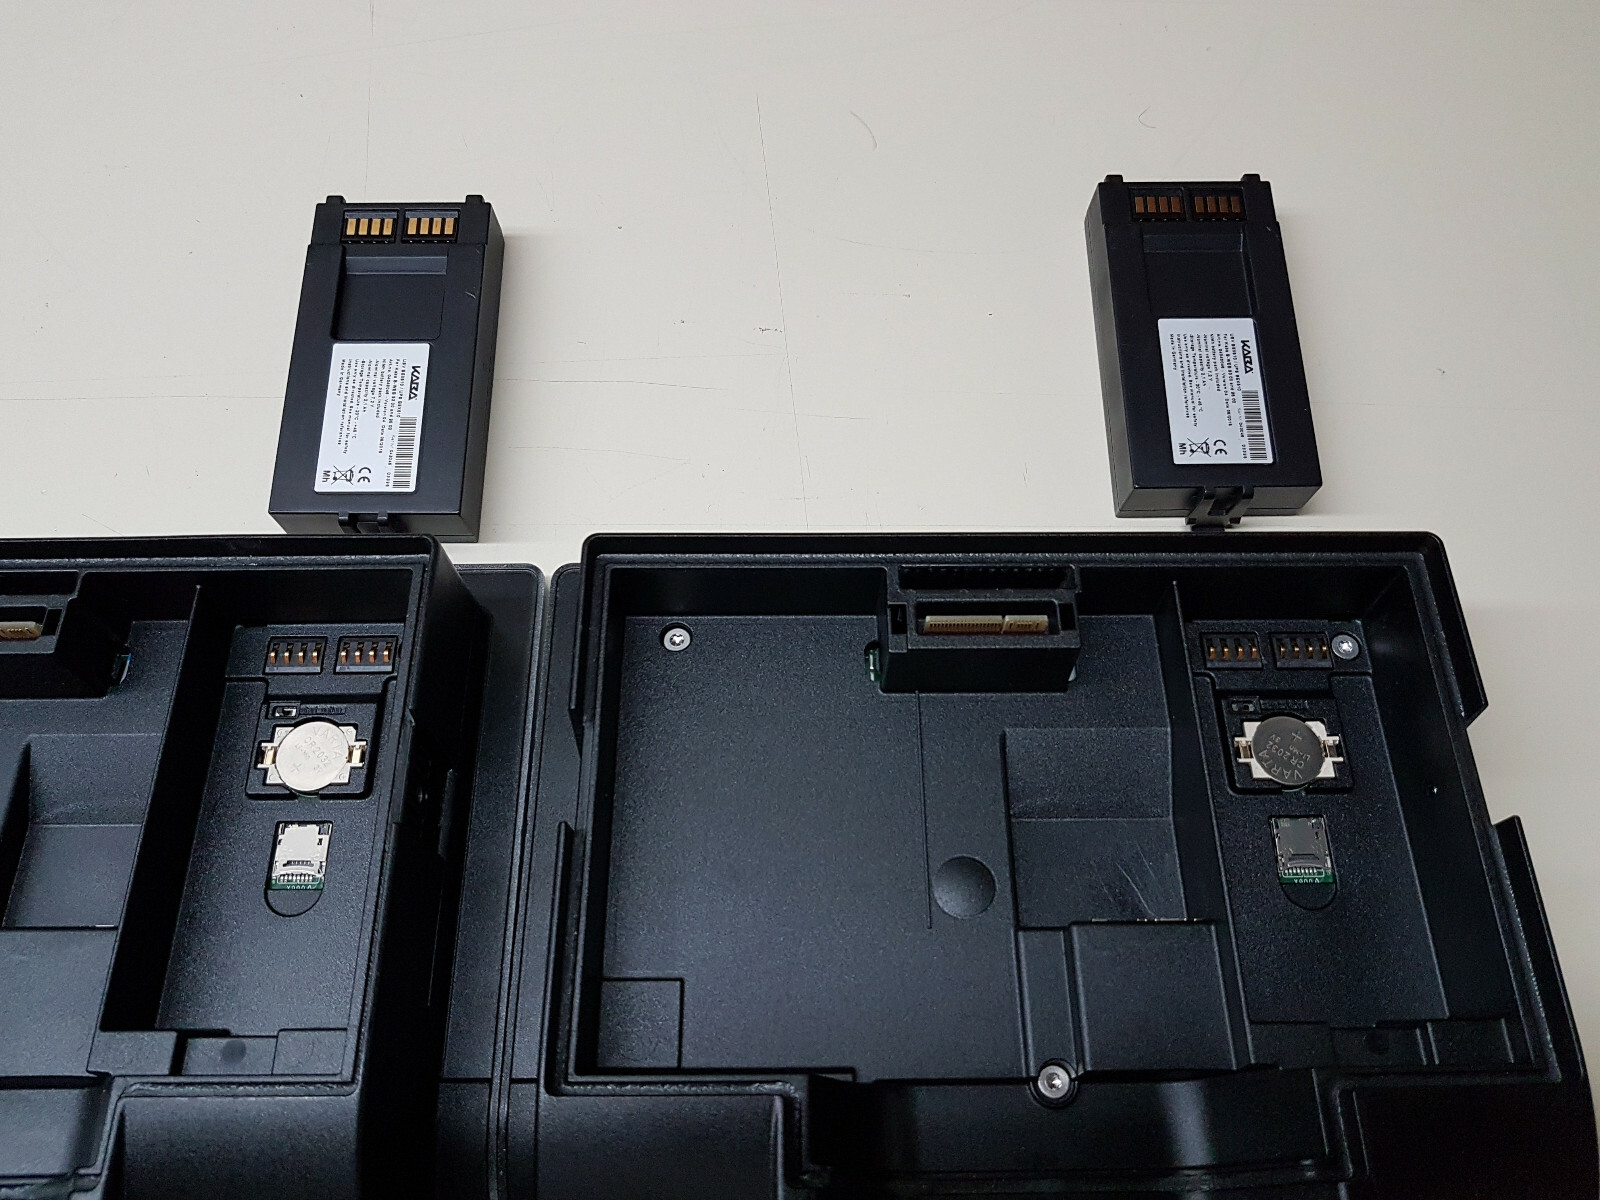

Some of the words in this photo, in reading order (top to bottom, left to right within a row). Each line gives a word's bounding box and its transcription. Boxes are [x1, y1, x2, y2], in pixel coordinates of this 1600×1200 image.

[1190, 352, 1199, 379] Temperature
[1240, 340, 1254, 373] KABA
[355, 378, 363, 406] Temperature
[408, 365, 420, 400] KABA
[1178, 442, 1187, 454] Mh
[321, 470, 330, 482] Mh
[312, 726, 342, 760] VARTA
[1258, 750, 1302, 780] VARTA
